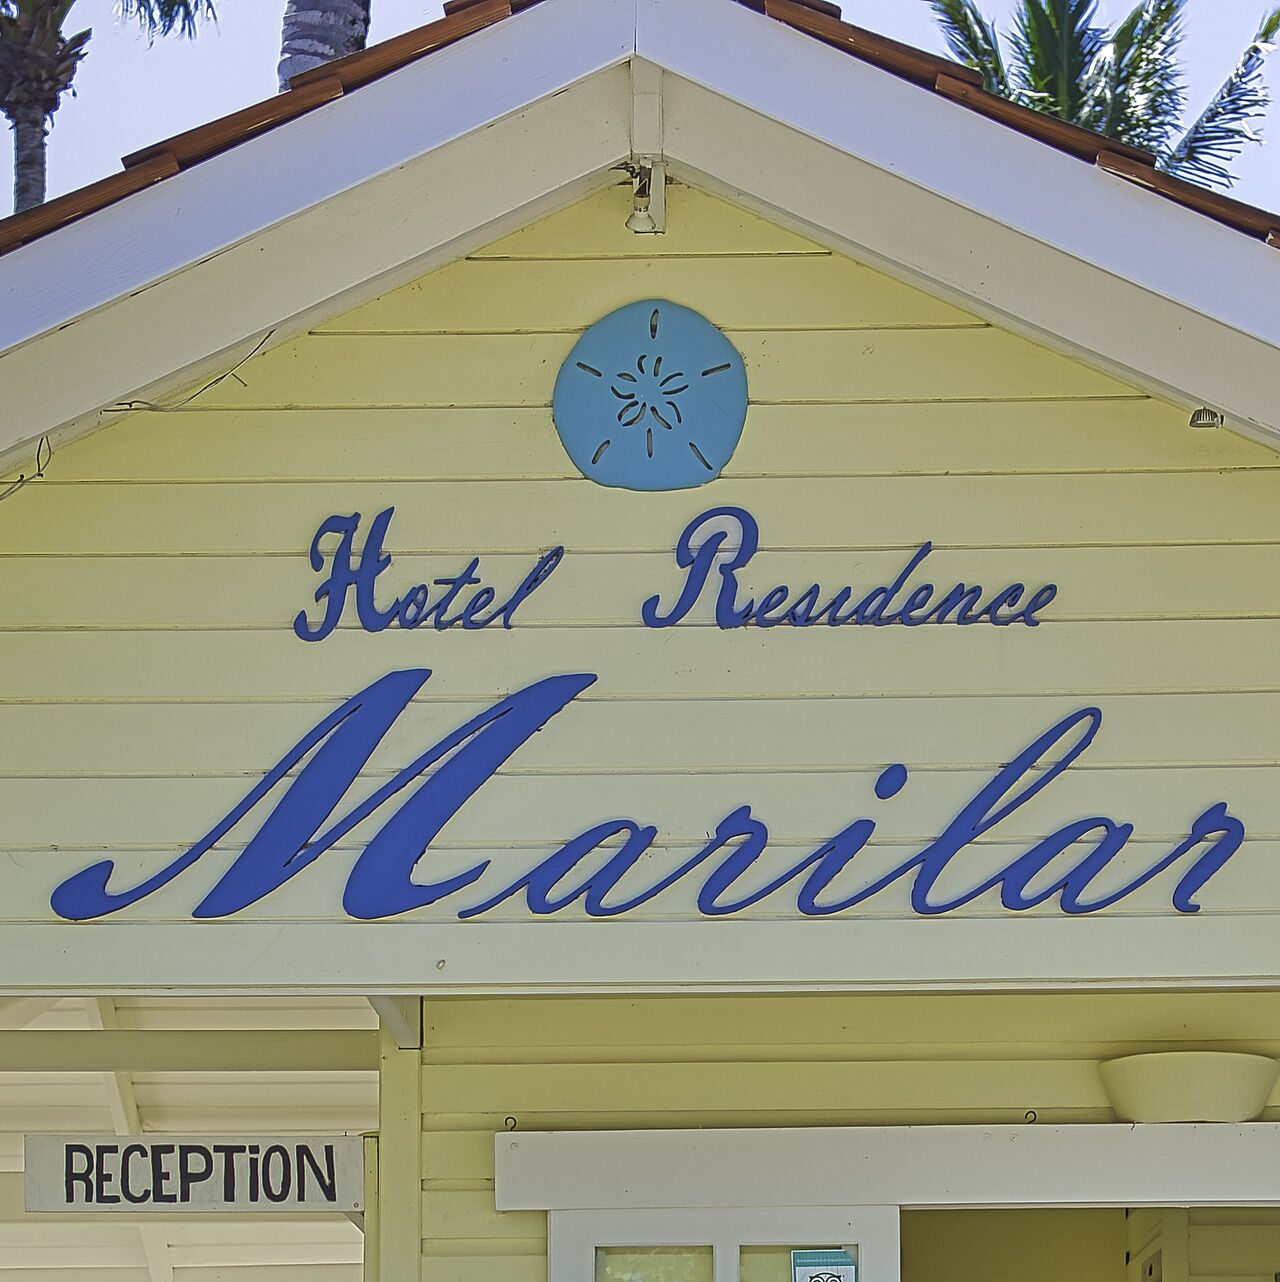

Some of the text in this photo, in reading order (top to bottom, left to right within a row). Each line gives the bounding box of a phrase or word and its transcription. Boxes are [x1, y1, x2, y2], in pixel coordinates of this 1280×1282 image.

[293, 505, 1058, 643] Hotel Residence
[49, 666, 1247, 921] Marilar
